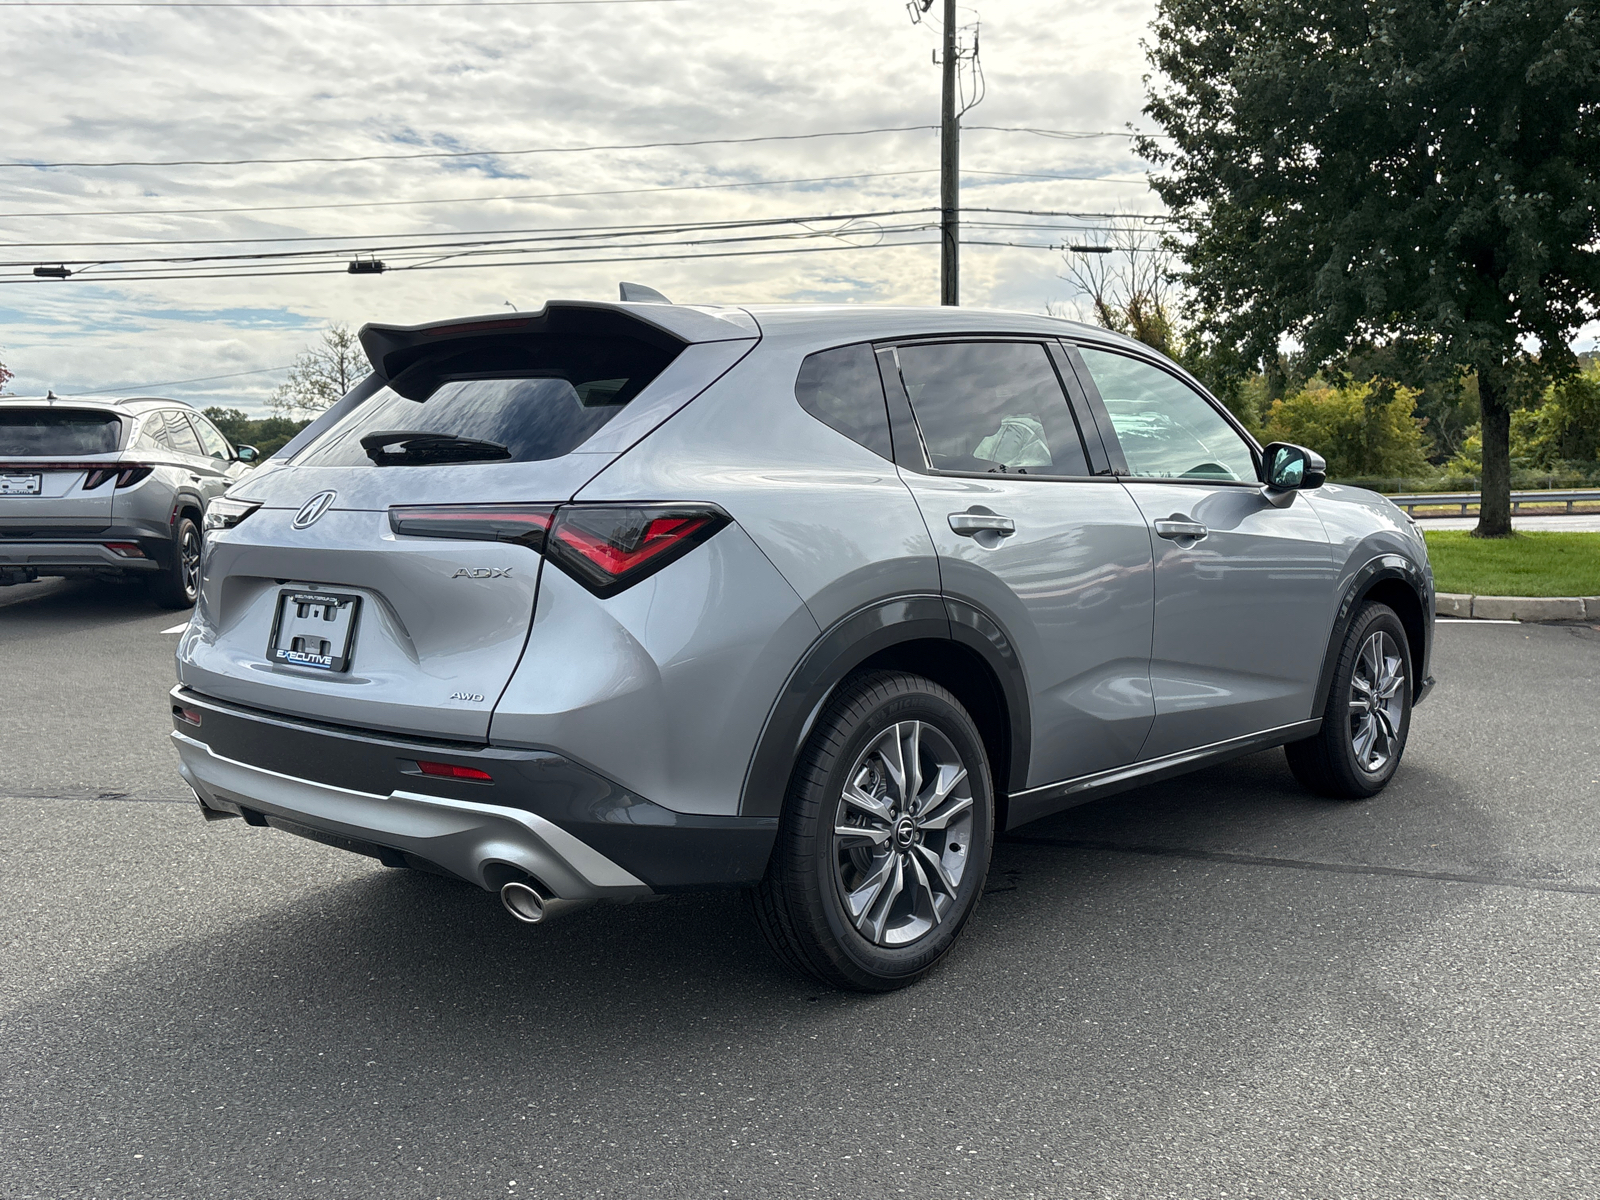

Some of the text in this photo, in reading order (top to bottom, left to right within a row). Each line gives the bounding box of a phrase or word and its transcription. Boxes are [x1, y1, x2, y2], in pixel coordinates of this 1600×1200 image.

[451, 567, 513, 579] ADX
[276, 649, 332, 665] EXECUTIVE
[449, 691, 485, 702] AWD
